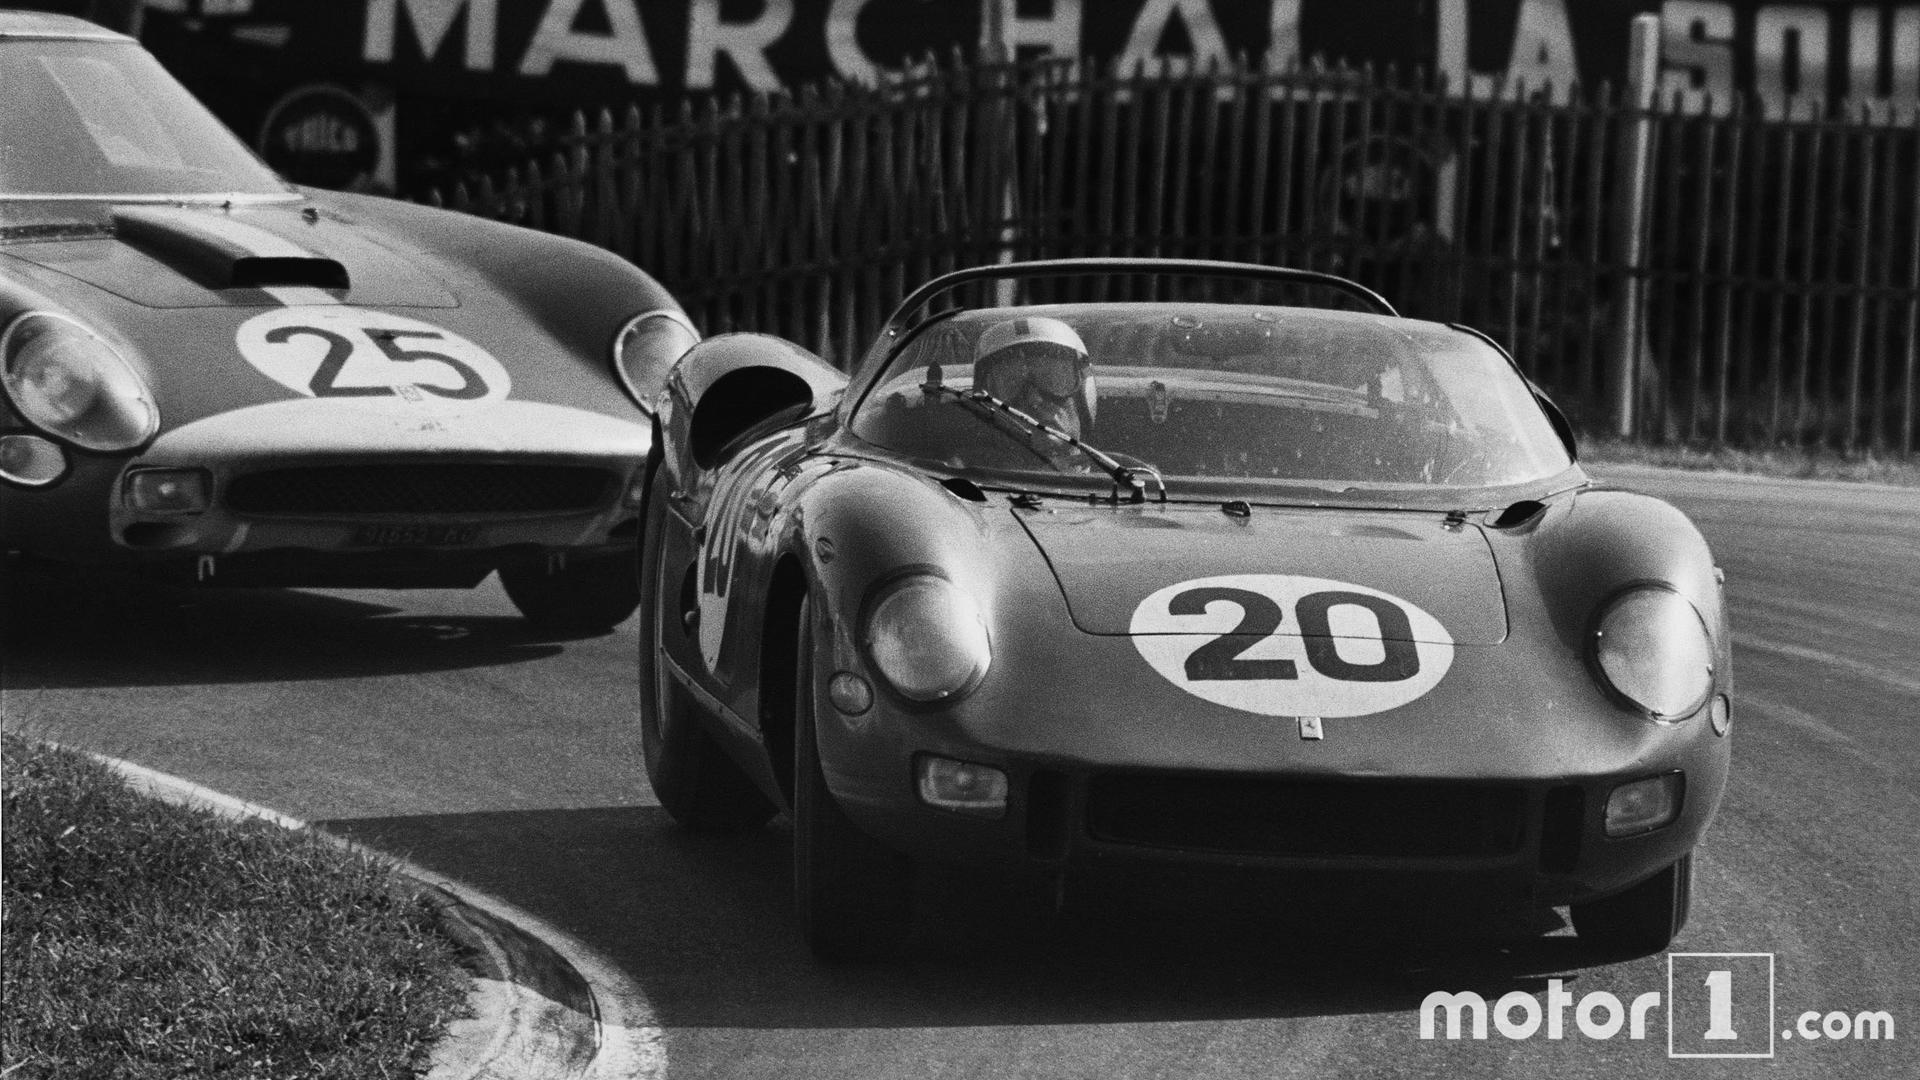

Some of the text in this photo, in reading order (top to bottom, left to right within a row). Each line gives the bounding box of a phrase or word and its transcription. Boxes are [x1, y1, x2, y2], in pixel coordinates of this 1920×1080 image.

[1437, 0, 1578, 107] LA
[265, 326, 489, 400] 25
[1168, 587, 1420, 682] 20
